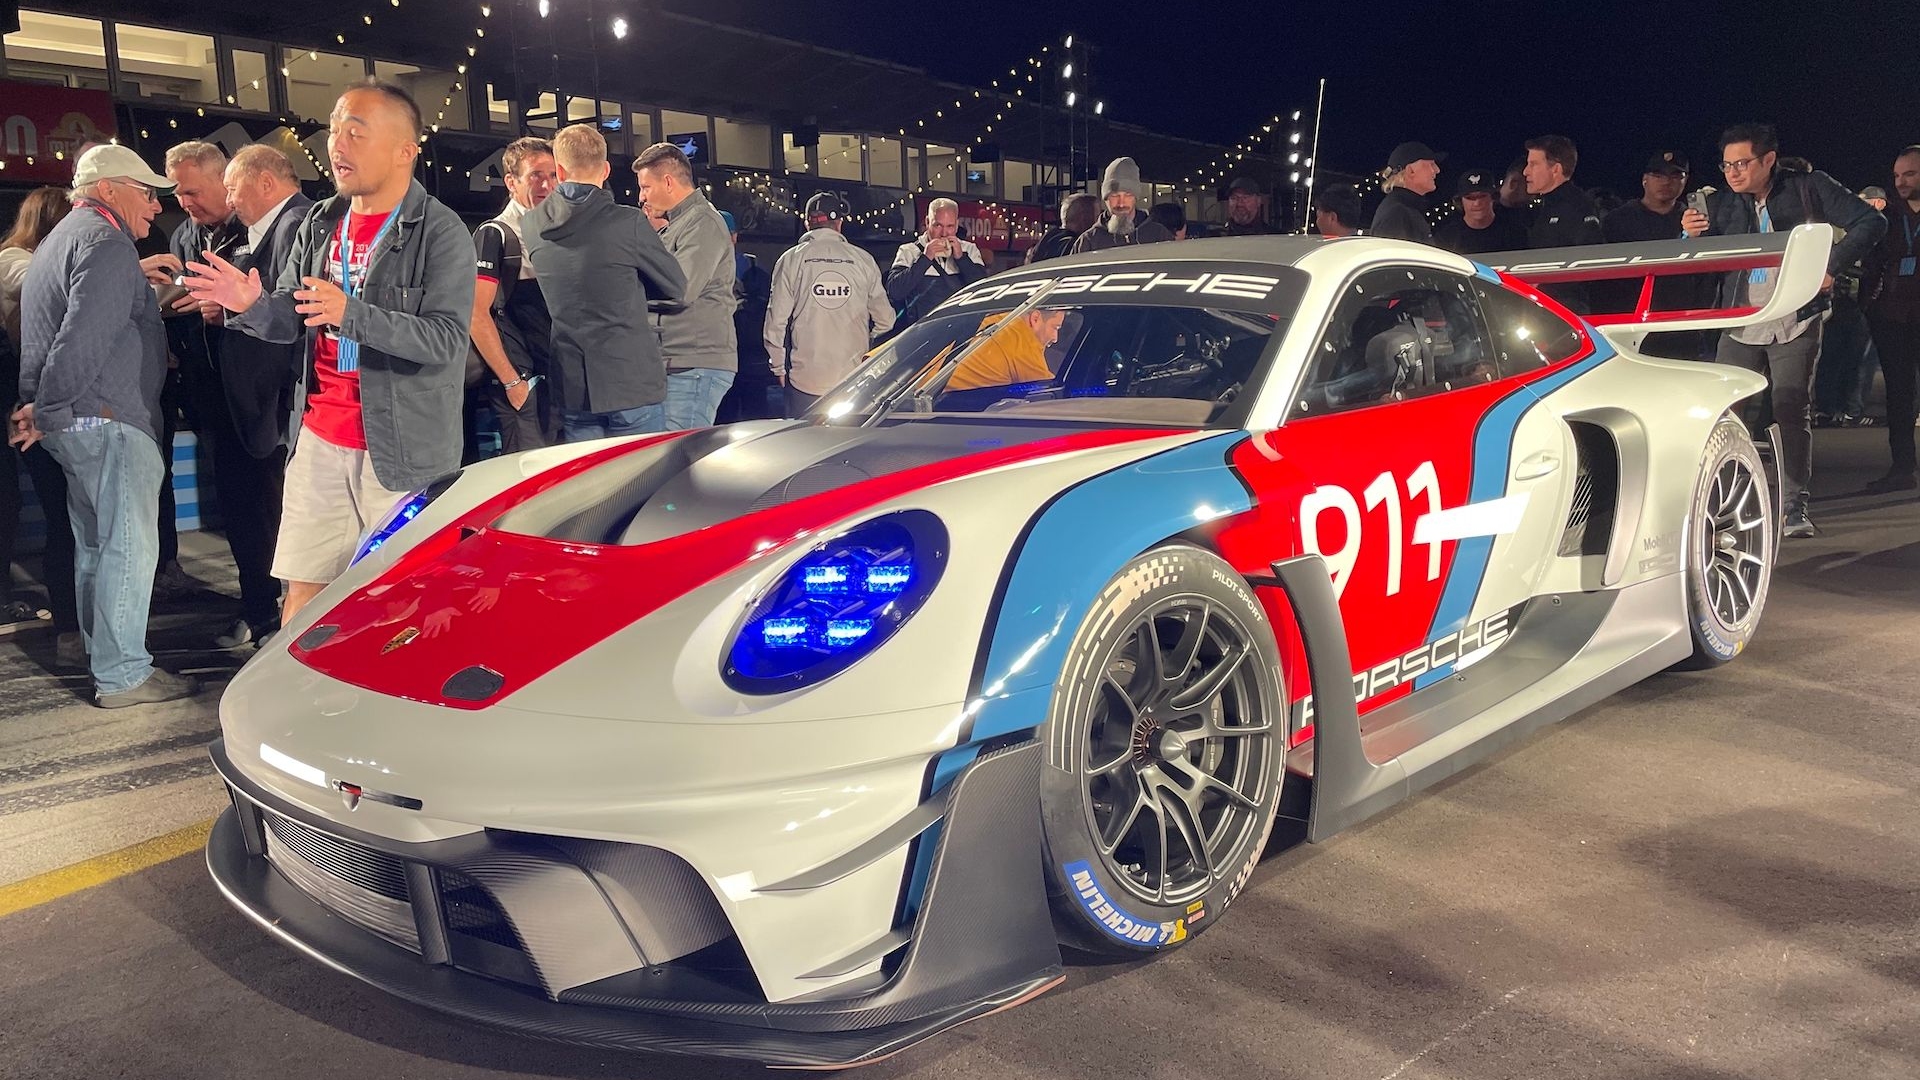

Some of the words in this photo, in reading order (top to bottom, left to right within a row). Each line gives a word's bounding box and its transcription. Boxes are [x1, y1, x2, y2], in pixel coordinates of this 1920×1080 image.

[804, 257, 855, 265] PORSCHE
[812, 284, 850, 296] Gulf
[926, 272, 1280, 317] PORSCHE
[1300, 460, 1443, 602] 911
[1212, 569, 1239, 592] PILOT
[1237, 588, 1263, 622] SPORT
[1700, 620, 1733, 657] MICHELIN
[1071, 870, 1158, 943] MICHELIN
